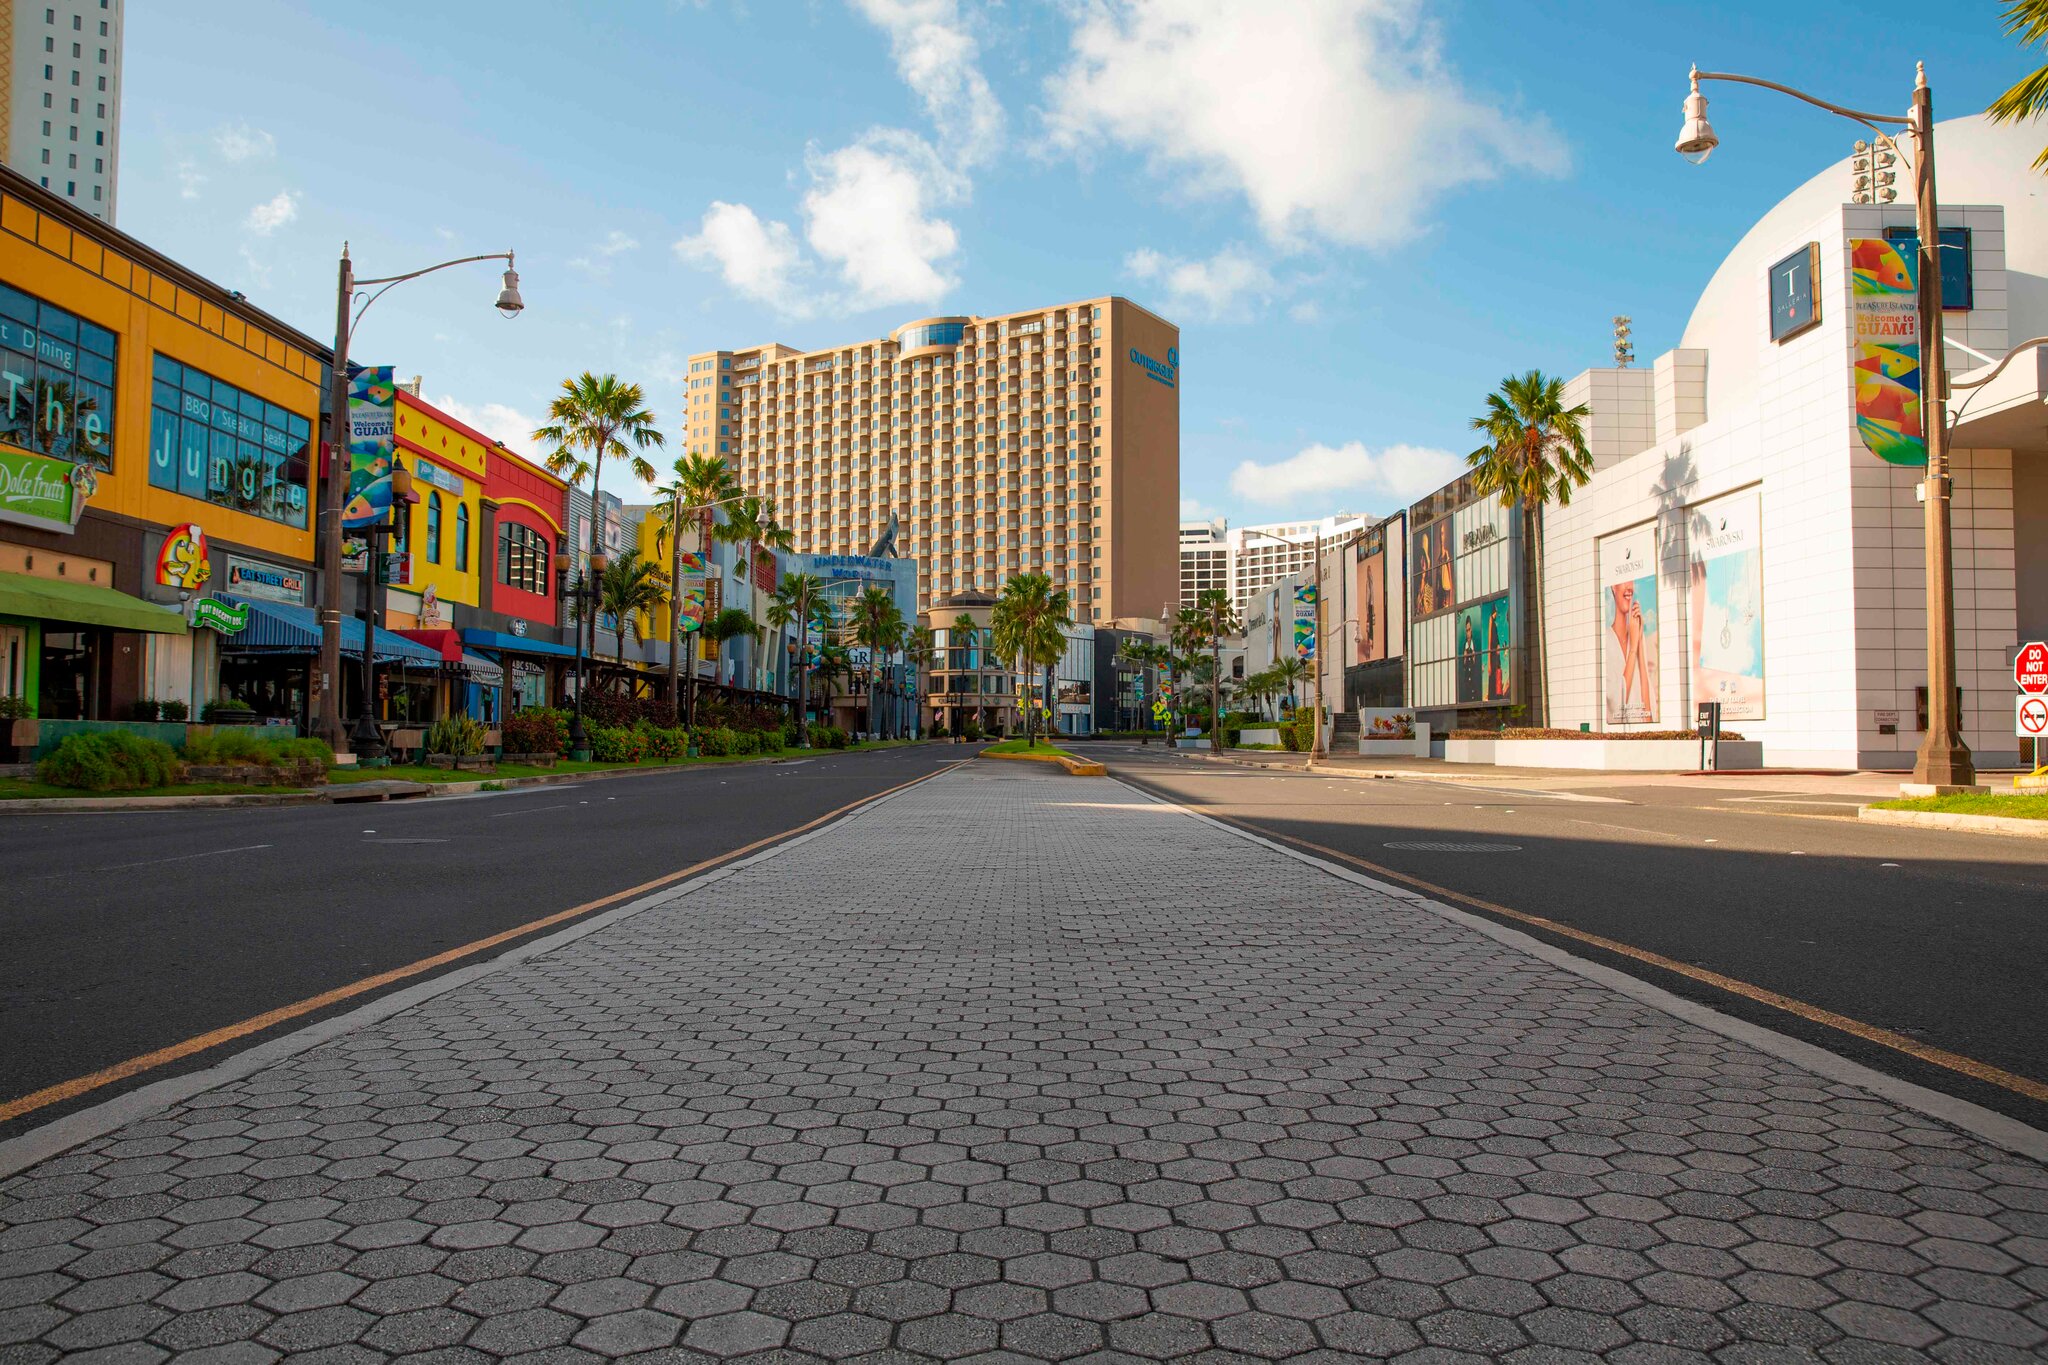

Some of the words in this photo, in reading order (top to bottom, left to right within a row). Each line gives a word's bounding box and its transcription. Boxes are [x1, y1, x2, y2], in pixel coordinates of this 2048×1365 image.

[1782, 265, 1800, 297] T
[1856, 301, 1888, 310] PLEASURE
[1889, 302, 1915, 310] ISLAND
[1857, 313, 1900, 322] Welcome
[1857, 322, 1914, 336] GUAM!
[1129, 347, 1175, 381] OUTRIGGER
[2, 370, 102, 446] The
[185, 396, 210, 421] BBQ
[222, 410, 249, 436] Steak
[264, 428, 299, 452] Seafood
[354, 426, 393, 436] GUAM!
[156, 428, 302, 512] Jungle
[0, 462, 32, 496] Dolce
[1463, 522, 1498, 551] PRADA
[1706, 530, 1744, 550] SWAROVSKI
[814, 555, 892, 572] UNDERWATER
[1615, 559, 1644, 576] SWAROVSKI
[241, 568, 255, 580] EAT
[256, 572, 283, 588] STREET
[283, 577, 303, 591] GRILL
[2028, 649, 2041, 660] DO
[512, 661, 523, 670] ABC
[2026, 661, 2044, 672] NOT
[2020, 674, 2048, 685] ENTER
